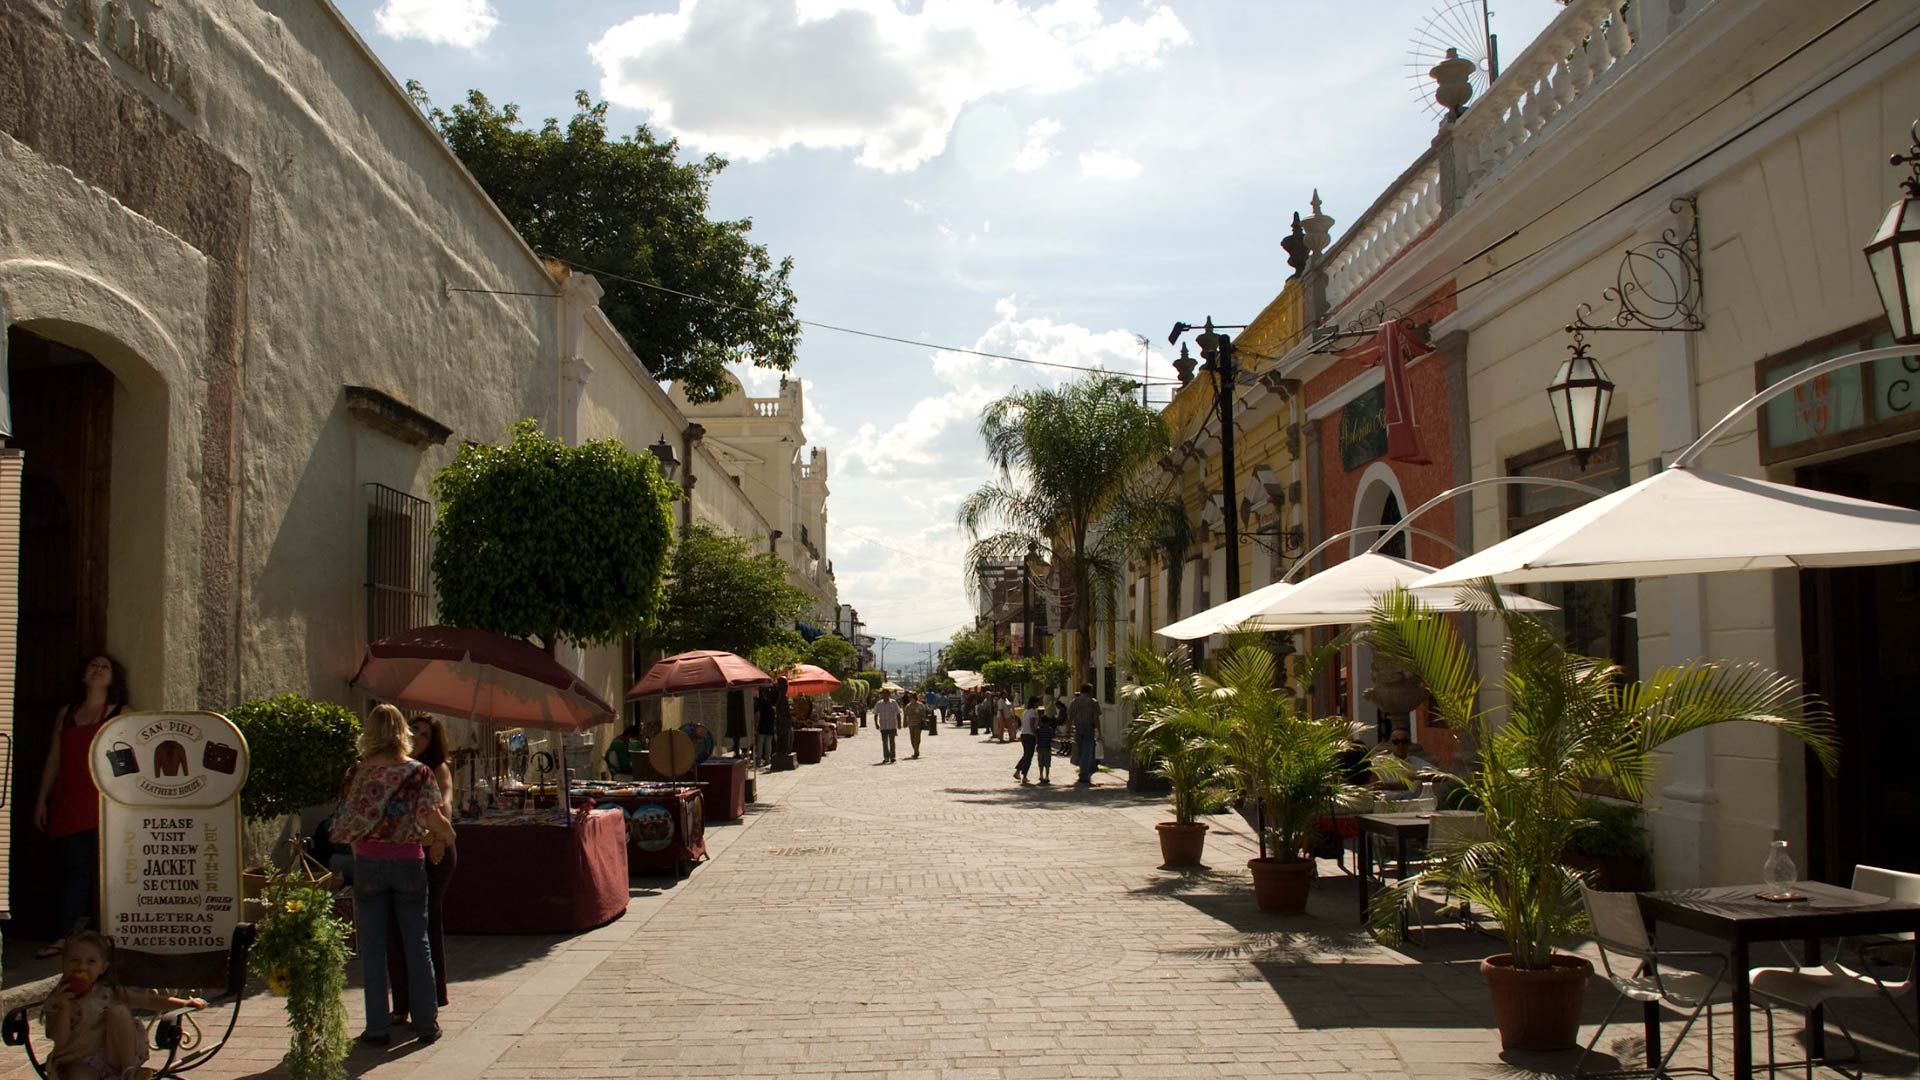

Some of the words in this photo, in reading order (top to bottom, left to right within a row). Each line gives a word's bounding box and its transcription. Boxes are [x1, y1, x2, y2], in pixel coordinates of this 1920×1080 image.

[141, 723, 163, 741] SAN
[169, 721, 194, 736] PIEL
[143, 819, 194, 829] PLEASE
[150, 832, 186, 842] VISIT
[143, 844, 170, 855] OUR
[171, 844, 198, 855] NEW
[204, 822, 219, 892] LEATHER
[143, 859, 196, 876] JACKET
[143, 879, 199, 891] SECTION
[137, 894, 202, 907] (CHAMARRAS)
[120, 912, 214, 923] BILLETERAS
[121, 925, 212, 935] SOMBREROS
[120, 936, 128, 946] Y
[132, 936, 225, 947] ACCESORIOS
